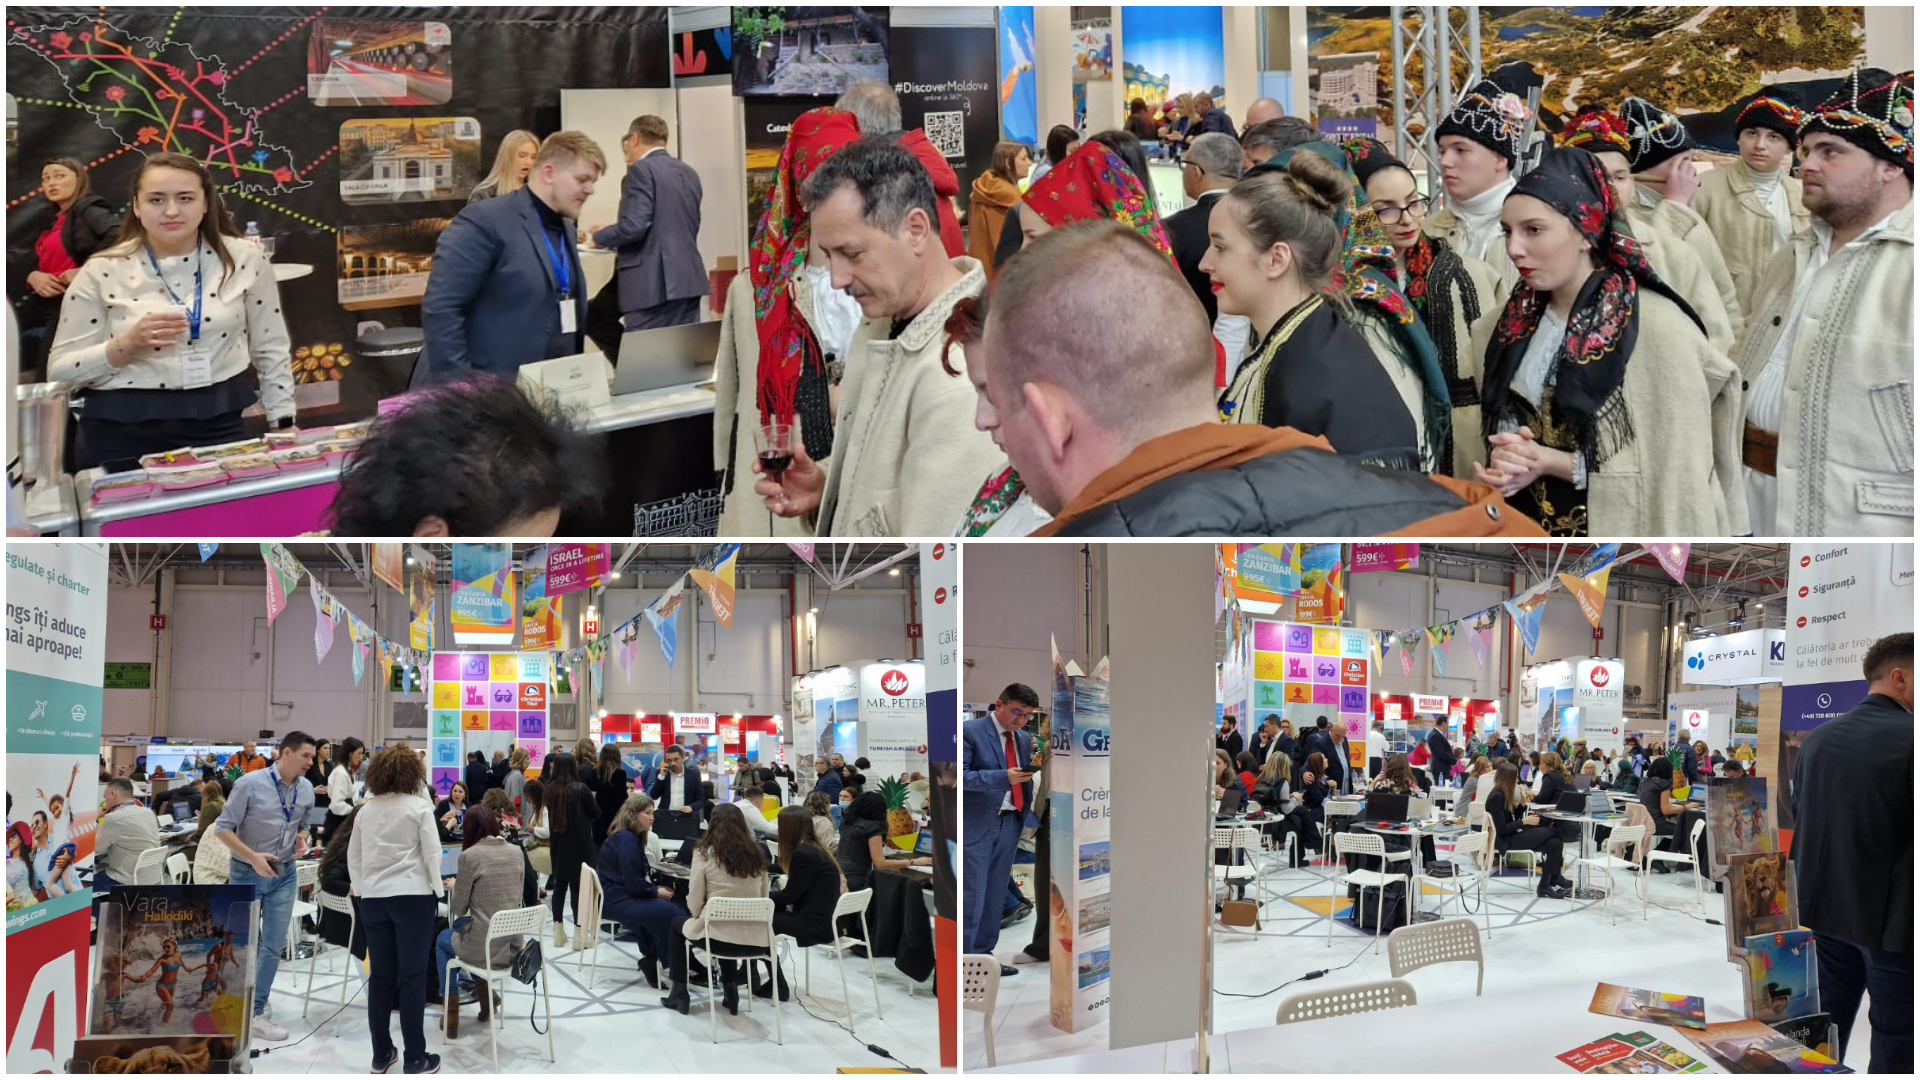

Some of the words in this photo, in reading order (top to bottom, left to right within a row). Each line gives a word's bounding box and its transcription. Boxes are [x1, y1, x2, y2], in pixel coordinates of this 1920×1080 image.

[894, 81, 988, 94] #DiscoverMoldova
[550, 548, 584, 565] ISRAEL
[1356, 552, 1379, 563] 599€
[1815, 547, 1848, 563] Confort
[1243, 559, 1292, 576] ZANZIBAR
[57, 574, 90, 596] charter
[550, 573, 571, 587] 599€
[1812, 575, 1856, 594] Siguranță
[457, 596, 503, 607] ZANZIBAR
[1299, 600, 1323, 608] RODOS
[153, 617, 162, 627] H
[1811, 611, 1846, 625] Respect
[51, 618, 86, 640] aduce
[524, 625, 547, 636] RODOS
[586, 622, 595, 632] H
[910, 627, 919, 636] H
[27, 634, 82, 660] aproape!
[1796, 640, 1836, 656] Călătoria
[1839, 641, 1850, 650] ar
[1708, 649, 1757, 662] CRYSTAL
[1796, 659, 1804, 669] la
[1806, 656, 1818, 668] fel
[1820, 655, 1832, 666] de
[1835, 652, 1858, 665] mult
[1580, 688, 1596, 697] MR.
[1597, 689, 1619, 698] PETER
[867, 699, 890, 708] MR.
[892, 698, 926, 708] PETER
[1080, 806, 1099, 819] de
[123, 891, 168, 911] Vara
[144, 910, 194, 921] Halkidiki
